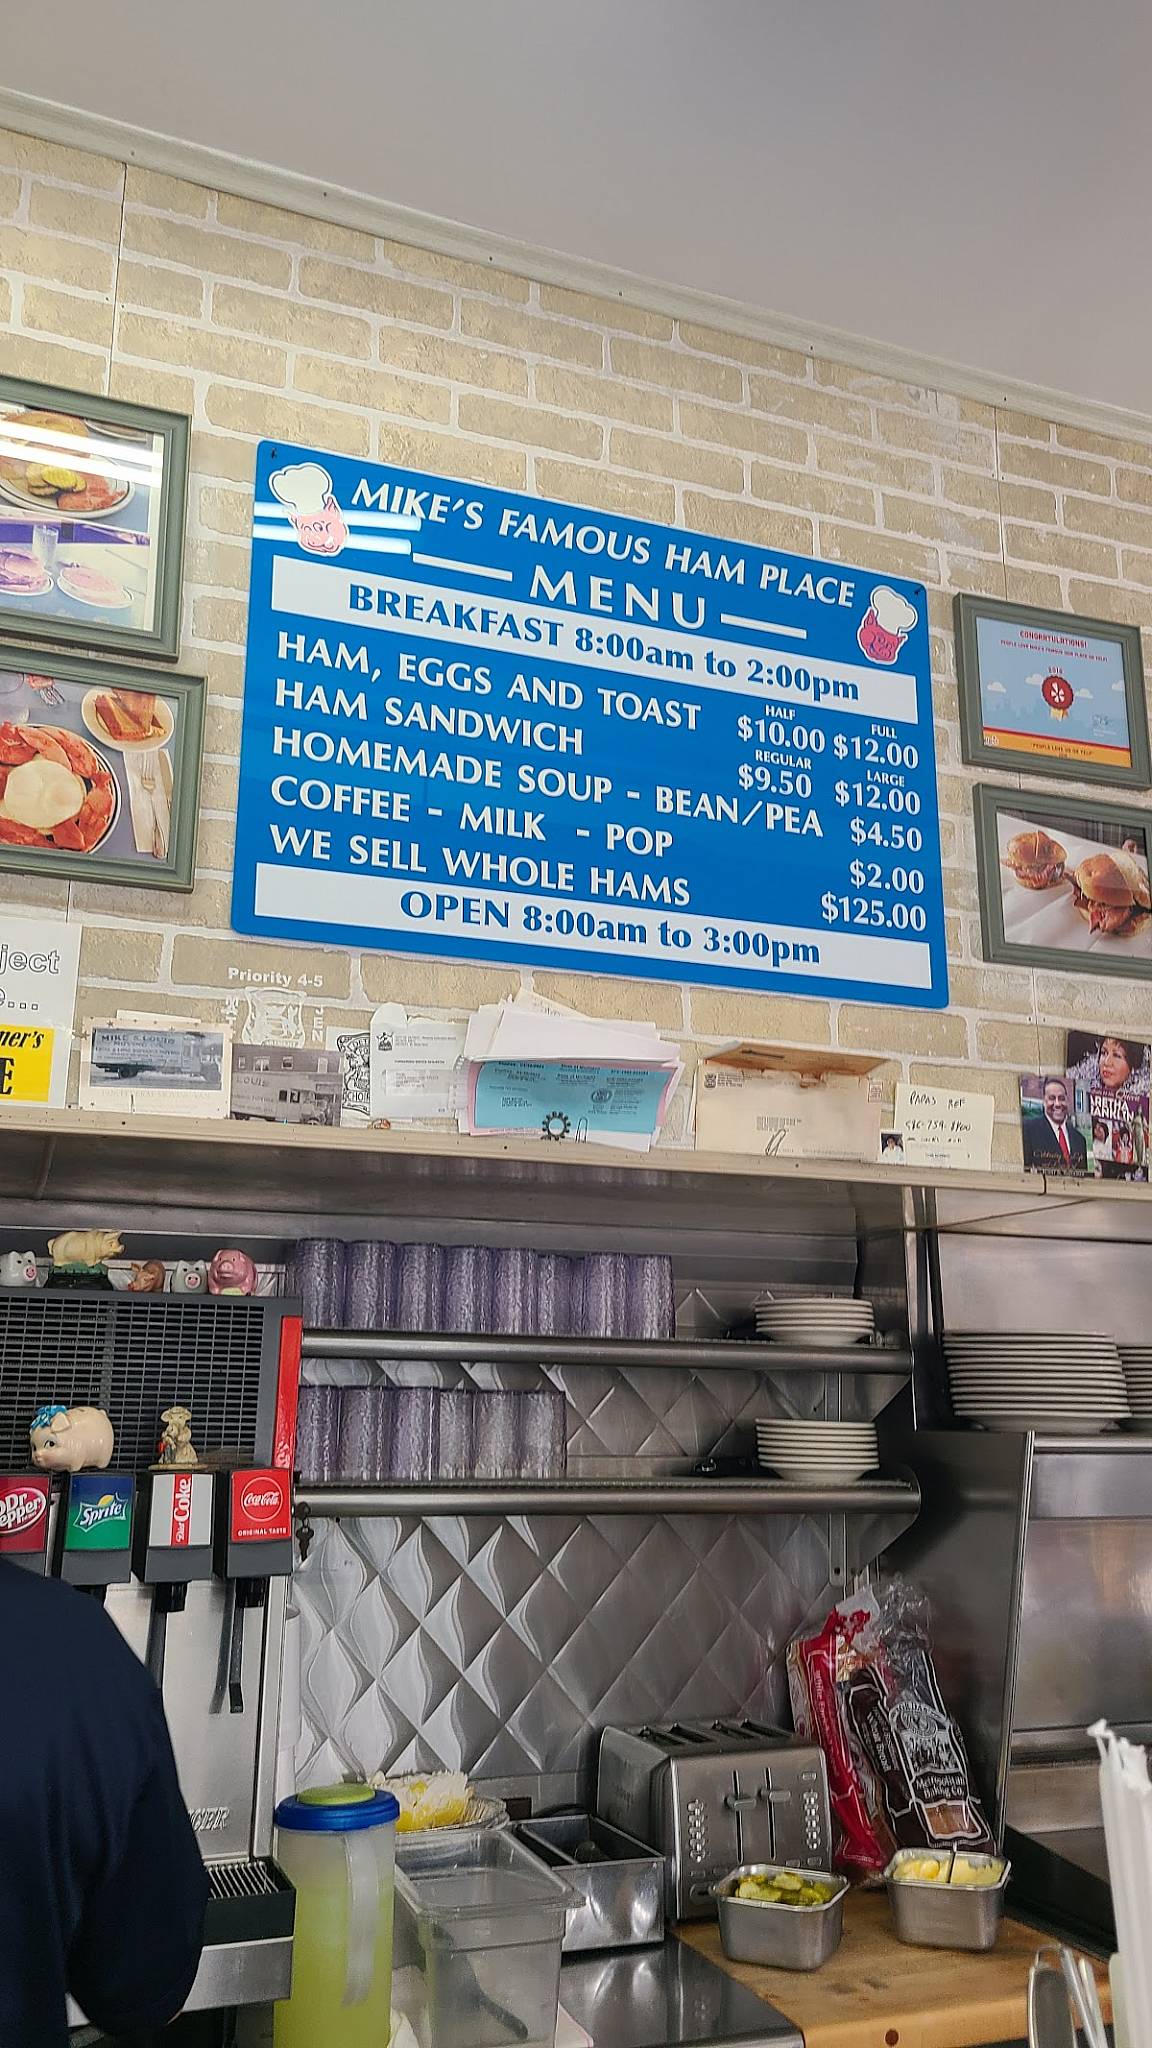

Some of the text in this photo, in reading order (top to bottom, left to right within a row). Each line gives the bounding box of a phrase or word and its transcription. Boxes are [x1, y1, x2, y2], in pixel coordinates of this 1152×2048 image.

[351, 478, 855, 607] MIKE'S FAMOUS HAM PLACE
[529, 564, 706, 630] MENU
[349, 583, 859, 703] BREAKFAST 8:00am to 2:00pm
[1019, 630, 1088, 648] CONGRATULATIONS!
[277, 631, 702, 731] HAM, EGGS AND TOAST
[275, 678, 584, 756] HAM SANDWICH
[765, 704, 796, 721] HALF
[871, 723, 897, 739] FULL
[737, 714, 919, 769] $10.00 $12.00
[755, 749, 812, 770] REGULAR
[272, 726, 503, 789] HOMEMADE
[518, 764, 613, 804] SOUP
[655, 786, 824, 837] BEAN/PEA
[850, 816, 923, 852] $4.50
[738, 763, 921, 815] $9.50 $12.00
[867, 769, 905, 787] LARGE
[271, 775, 411, 822] COFFEE
[460, 802, 546, 841] MILK
[606, 823, 674, 857] POP
[849, 859, 925, 894] $2.00
[269, 824, 927, 932] WE SELL WHOLE HAMS $125.00
[400, 890, 820, 968] OPEN 8:00am to 3:00pm
[228, 967, 324, 989] Priority 4-5
[4, 1492, 28, 1513] Dr
[80, 1500, 122, 1526] Sprite
[173, 1477, 192, 1523] Coke
[237, 1528, 268, 1537] ORIGINAL
